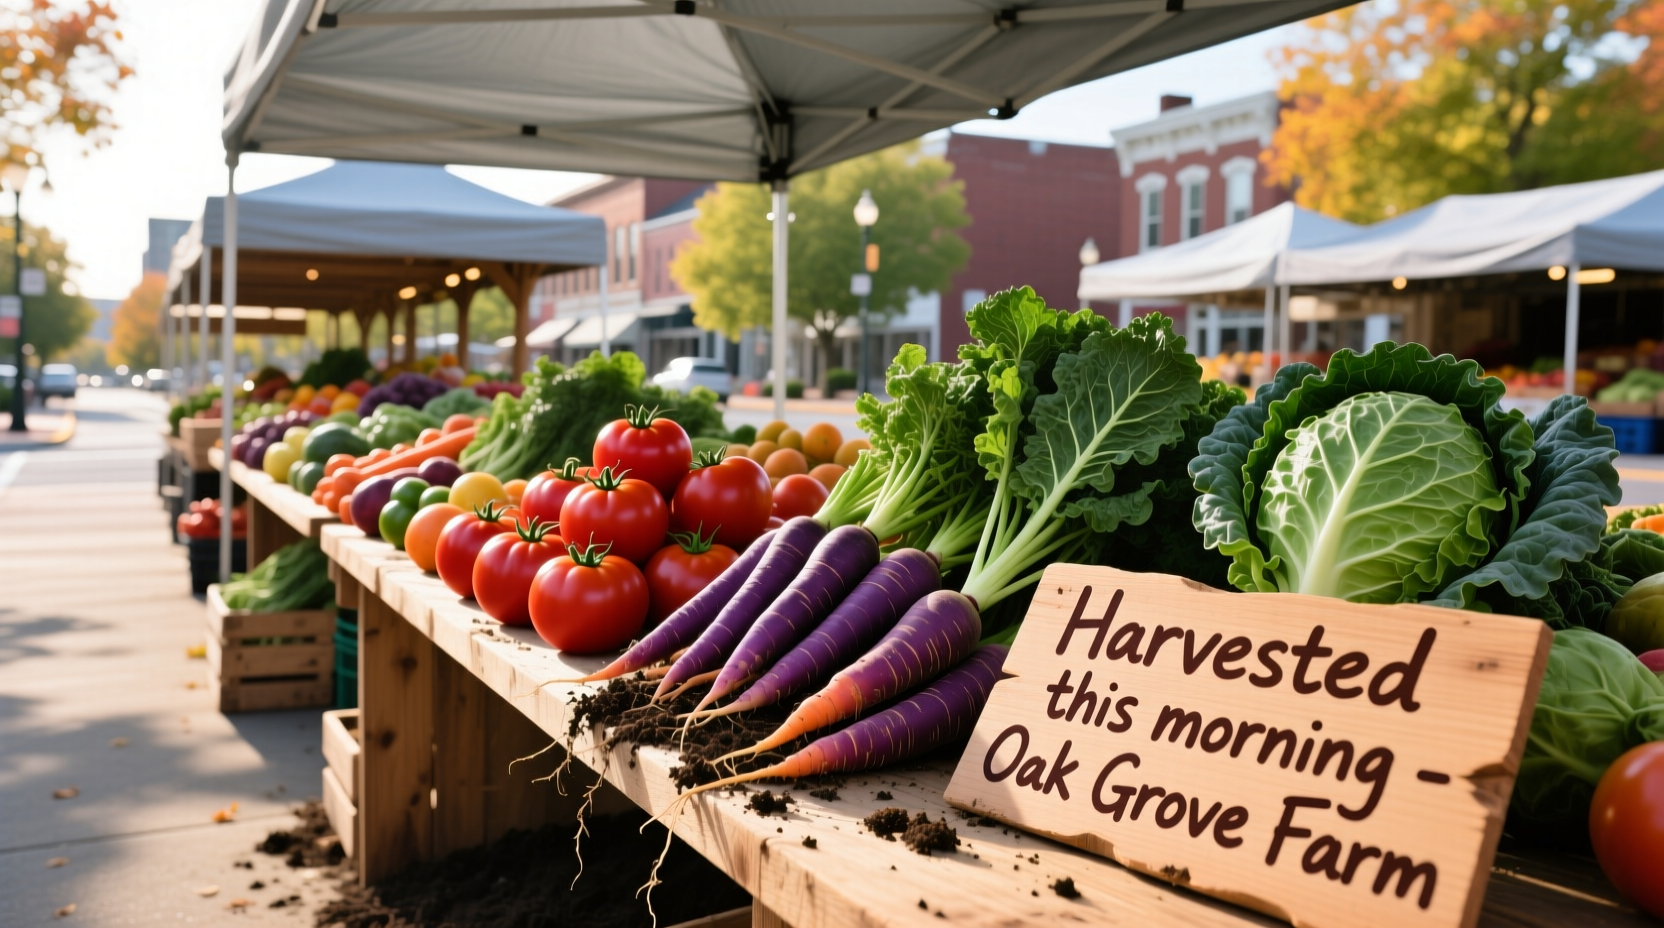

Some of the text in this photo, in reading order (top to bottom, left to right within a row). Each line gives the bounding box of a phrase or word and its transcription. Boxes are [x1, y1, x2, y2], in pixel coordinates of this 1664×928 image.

[1055, 585, 1437, 713] Harvested
[982, 724, 1438, 910] Oak Grove Farm
[1046, 669, 1139, 733] this
[1150, 705, 1395, 822] morning
